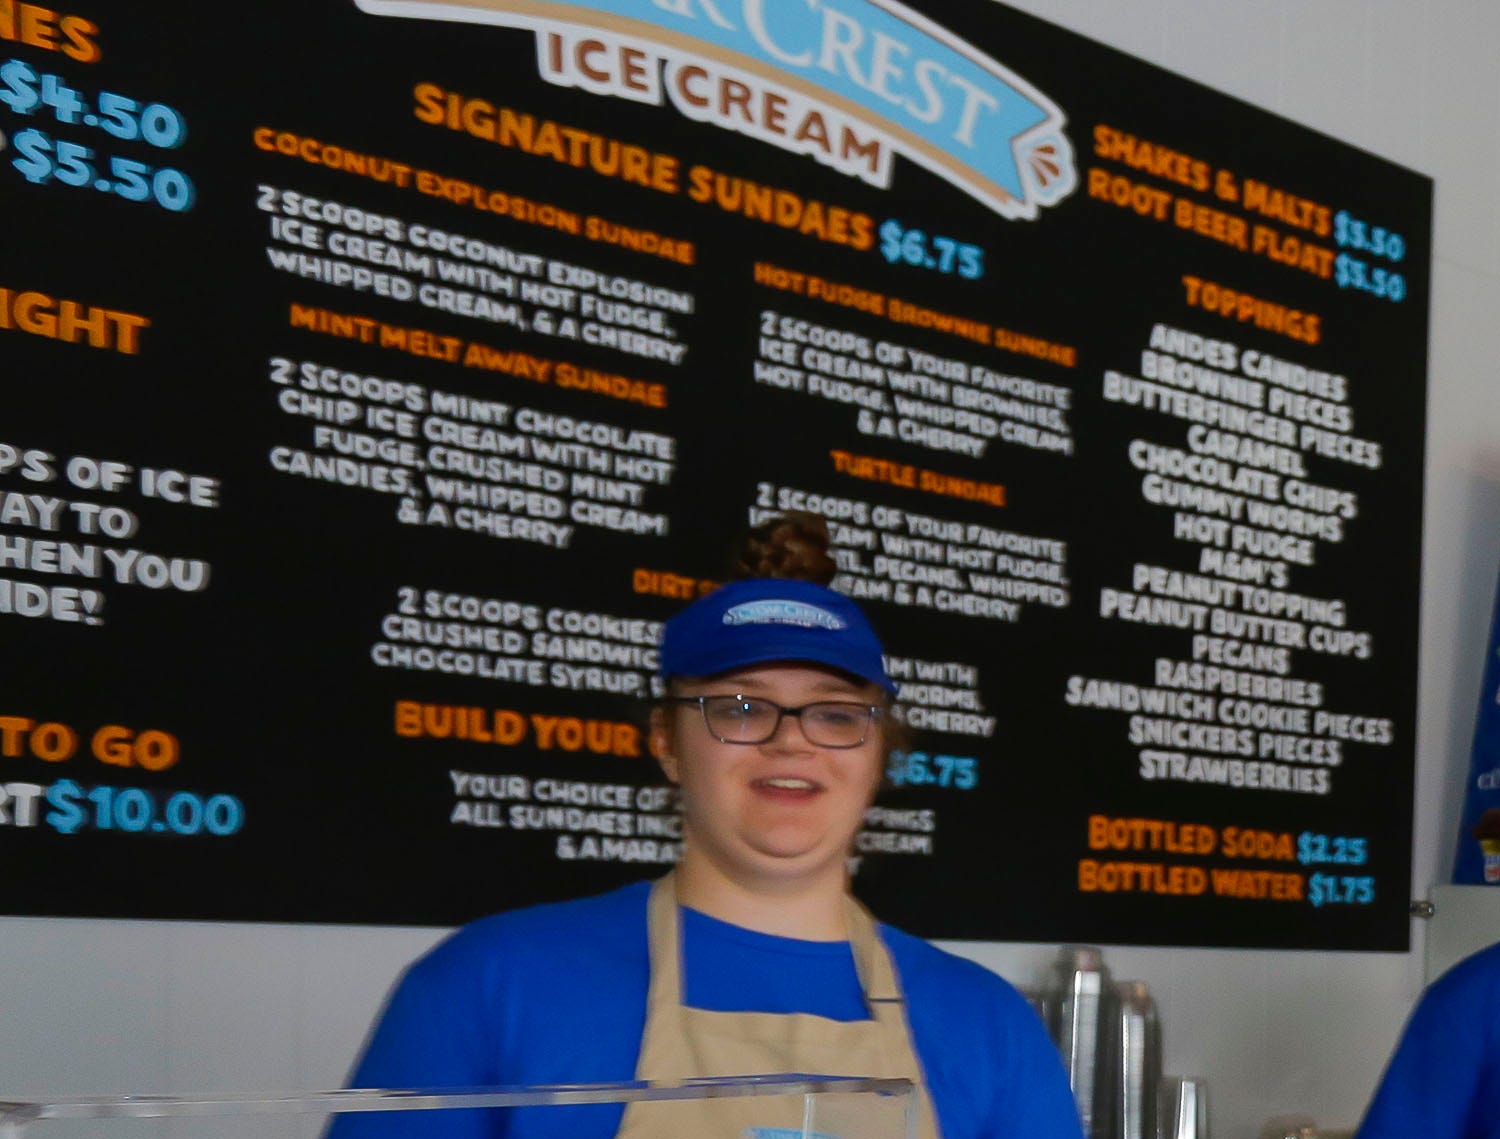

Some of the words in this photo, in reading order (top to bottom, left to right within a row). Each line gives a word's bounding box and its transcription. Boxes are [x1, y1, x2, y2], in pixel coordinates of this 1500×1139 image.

[0, 58, 188, 149] $4.50
[548, 32, 650, 92] ICE
[674, 65, 881, 175] CREAM
[742, 0, 999, 148] CREST
[12, 128, 196, 212] $5.50
[253, 126, 412, 189] COCONUT
[415, 168, 582, 236] EXPLOSION
[584, 214, 697, 266] SUNDAE
[413, 81, 682, 194] SIGNATURE
[688, 164, 875, 250] SUNDAES
[878, 218, 985, 281] $6.75
[1093, 123, 1211, 192] SHAKES
[1215, 169, 1240, 203] &
[1243, 178, 1332, 237] MALTS
[256, 183, 279, 212] 2
[281, 189, 404, 242] SCOOPS
[408, 223, 546, 278] COCONUT
[547, 259, 696, 315] EXPLOSION
[1087, 166, 1173, 223] ROOT
[1174, 197, 1250, 252] BEER
[1252, 223, 1335, 280] FLOAT
[271, 215, 323, 250] ICE
[328, 231, 434, 279] CREAM
[436, 257, 518, 300] WITH
[520, 279, 577, 312] HOT
[266, 246, 415, 301] WHIPPED
[557, 317, 580, 341] A
[581, 321, 690, 366] CHERRY
[754, 261, 806, 295] HOT
[806, 274, 886, 318] FUDGE
[887, 297, 993, 346] BROWNIE
[994, 327, 1078, 369] SUNDAE
[1181, 273, 1322, 346] TOPPINGS
[290, 301, 378, 344] MINT
[379, 323, 463, 364] MELT
[463, 342, 551, 385] AWAY
[554, 361, 669, 410] SUNDAE
[760, 310, 779, 336] 2
[779, 316, 874, 361] SCOOPS
[875, 340, 908, 367] OF
[905, 349, 970, 383] YOUR
[970, 365, 1073, 411] FAVORITE
[760, 336, 800, 366] ICE
[801, 347, 889, 387] CREAM
[885, 368, 950, 403] WITH
[1149, 321, 1239, 372] ANDES
[1239, 348, 1350, 403] CANDIES
[269, 356, 297, 385] 2
[299, 361, 428, 412] SCOOPS
[430, 389, 513, 428] MINT
[513, 406, 678, 462] CHOCOLATE
[753, 360, 806, 392] HOT
[893, 393, 1000, 440] WHIPPED
[1000, 419, 1075, 457] CREAM
[1102, 369, 1299, 449] BUTTERFINGER
[1299, 423, 1384, 471] PIECES
[1140, 348, 1267, 409] BROWNIE
[1268, 386, 1354, 434] PIECES
[277, 388, 363, 426] CHIP
[365, 404, 419, 439] ICE
[422, 415, 529, 459] CREAM
[529, 436, 613, 473] WITH
[613, 454, 675, 486] HOT
[875, 415, 898, 439] A
[897, 418, 987, 459] CHERRY
[1186, 422, 1309, 478] CARAMEL
[66, 455, 133, 492] OF
[139, 468, 221, 508] ICE
[425, 474, 567, 521] WHIPPED
[568, 500, 672, 538] CREAM
[427, 444, 571, 492] CRUSHED
[571, 472, 647, 507] MINT
[829, 449, 918, 491] TURTLE
[919, 468, 1007, 508] SUNDAE
[1126, 437, 1282, 501] CHOCOLATE
[1282, 477, 1358, 520] CHIPS
[69, 501, 139, 539] TO
[396, 497, 424, 525] &
[425, 502, 453, 528] A
[453, 506, 577, 550] CHERRY
[757, 481, 775, 507] 2
[776, 485, 873, 526] SCOOPS
[871, 505, 905, 529] OF
[903, 512, 966, 545] YOUR
[965, 522, 1070, 564] FAVORITE
[1140, 472, 1248, 521] GUMMY
[1246, 498, 1344, 543] WORMS
[1173, 511, 1231, 548] HOT
[1229, 524, 1316, 567] FUDGE
[104, 549, 211, 592] YOU
[633, 567, 698, 599] DIRT
[880, 532, 946, 564] WITH
[946, 543, 996, 572] HOT
[397, 585, 421, 616] 2
[424, 589, 541, 631] SCOOPS
[915, 585, 935, 608] A
[933, 587, 1022, 625] CHERRY
[967, 571, 1073, 609] WHIPPED
[1132, 562, 1238, 608] PEANUT
[1237, 581, 1348, 628] TOPPING
[381, 613, 528, 656] CRUSHED
[1099, 585, 1211, 632] PEANUT
[1210, 606, 1307, 650] BUTTER
[1307, 624, 1374, 661] CUPS
[1190, 633, 1292, 676] PECANS
[370, 641, 548, 687] CHOCOLATE
[914, 659, 978, 689] WITH
[1154, 656, 1325, 708] RASPBERRIES
[394, 699, 528, 747] BUILD
[530, 712, 644, 758] YOUR
[906, 705, 998, 739] CHERRY
[1064, 674, 1216, 722] SANDWICH
[1217, 697, 1312, 734] COOKIE
[1312, 708, 1395, 747] PIECES
[1127, 713, 1256, 758] SNICKERS
[1257, 731, 1345, 768] PIECES
[0, 715, 78, 763] TO
[91, 724, 181, 772] GO
[1138, 749, 1333, 796] STRAWBERRIES
[46, 778, 247, 835] $10.00
[449, 768, 532, 800] YOUR
[532, 777, 635, 810] CHOICE
[635, 785, 672, 812] OF
[450, 801, 504, 829] ALL
[508, 805, 633, 838] SUNDAES
[578, 836, 602, 860] A
[1087, 814, 1216, 855] BOTTLED
[1220, 825, 1296, 862] SODA
[1077, 858, 1208, 896] BOTTLED
[1209, 867, 1305, 901] WATER
